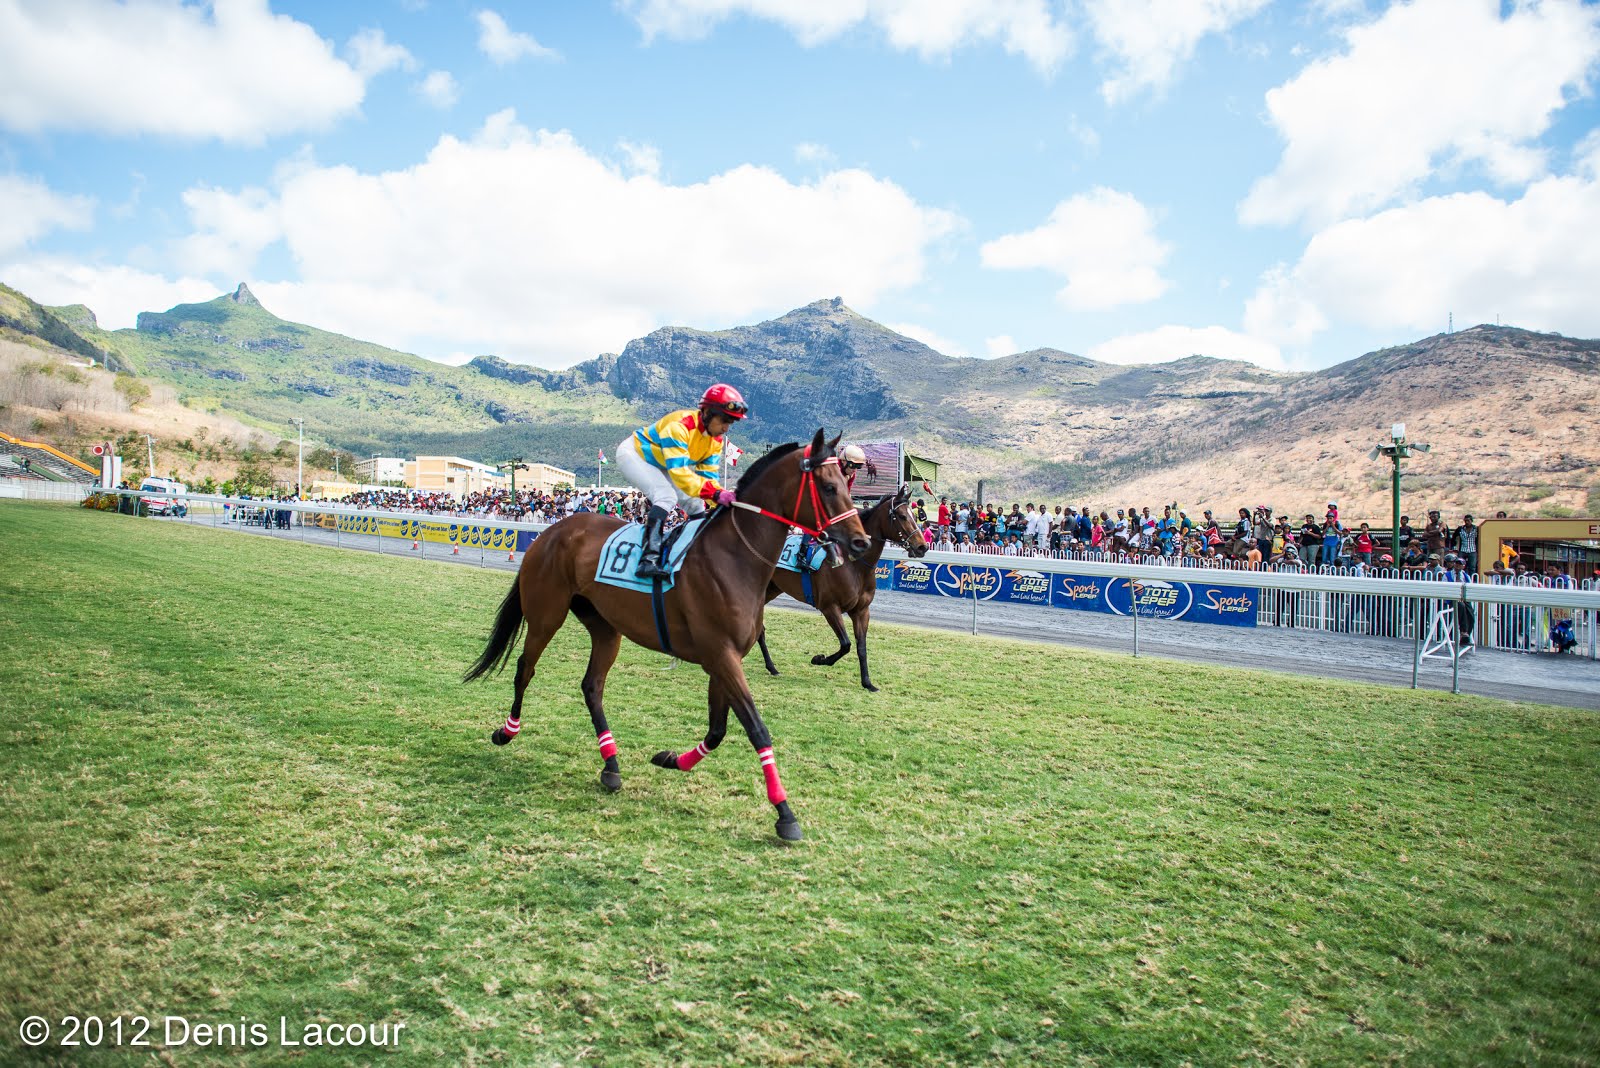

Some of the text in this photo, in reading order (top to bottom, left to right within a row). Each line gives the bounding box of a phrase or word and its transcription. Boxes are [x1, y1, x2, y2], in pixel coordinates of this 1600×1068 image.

[1588, 524, 1600, 535] E
[610, 541, 635, 574] 8
[781, 544, 795, 562] 5
[909, 567, 932, 576] TOTE
[901, 574, 930, 583] LEPEP
[1022, 577, 1050, 587] TOTE
[1013, 584, 1048, 593] LEPEP
[1056, 578, 1100, 601] Sports
[1144, 587, 1179, 598] TOTE
[1133, 595, 1177, 607] LEPEP
[1197, 589, 1252, 614] Sports
[1221, 605, 1249, 613] LEPEP
